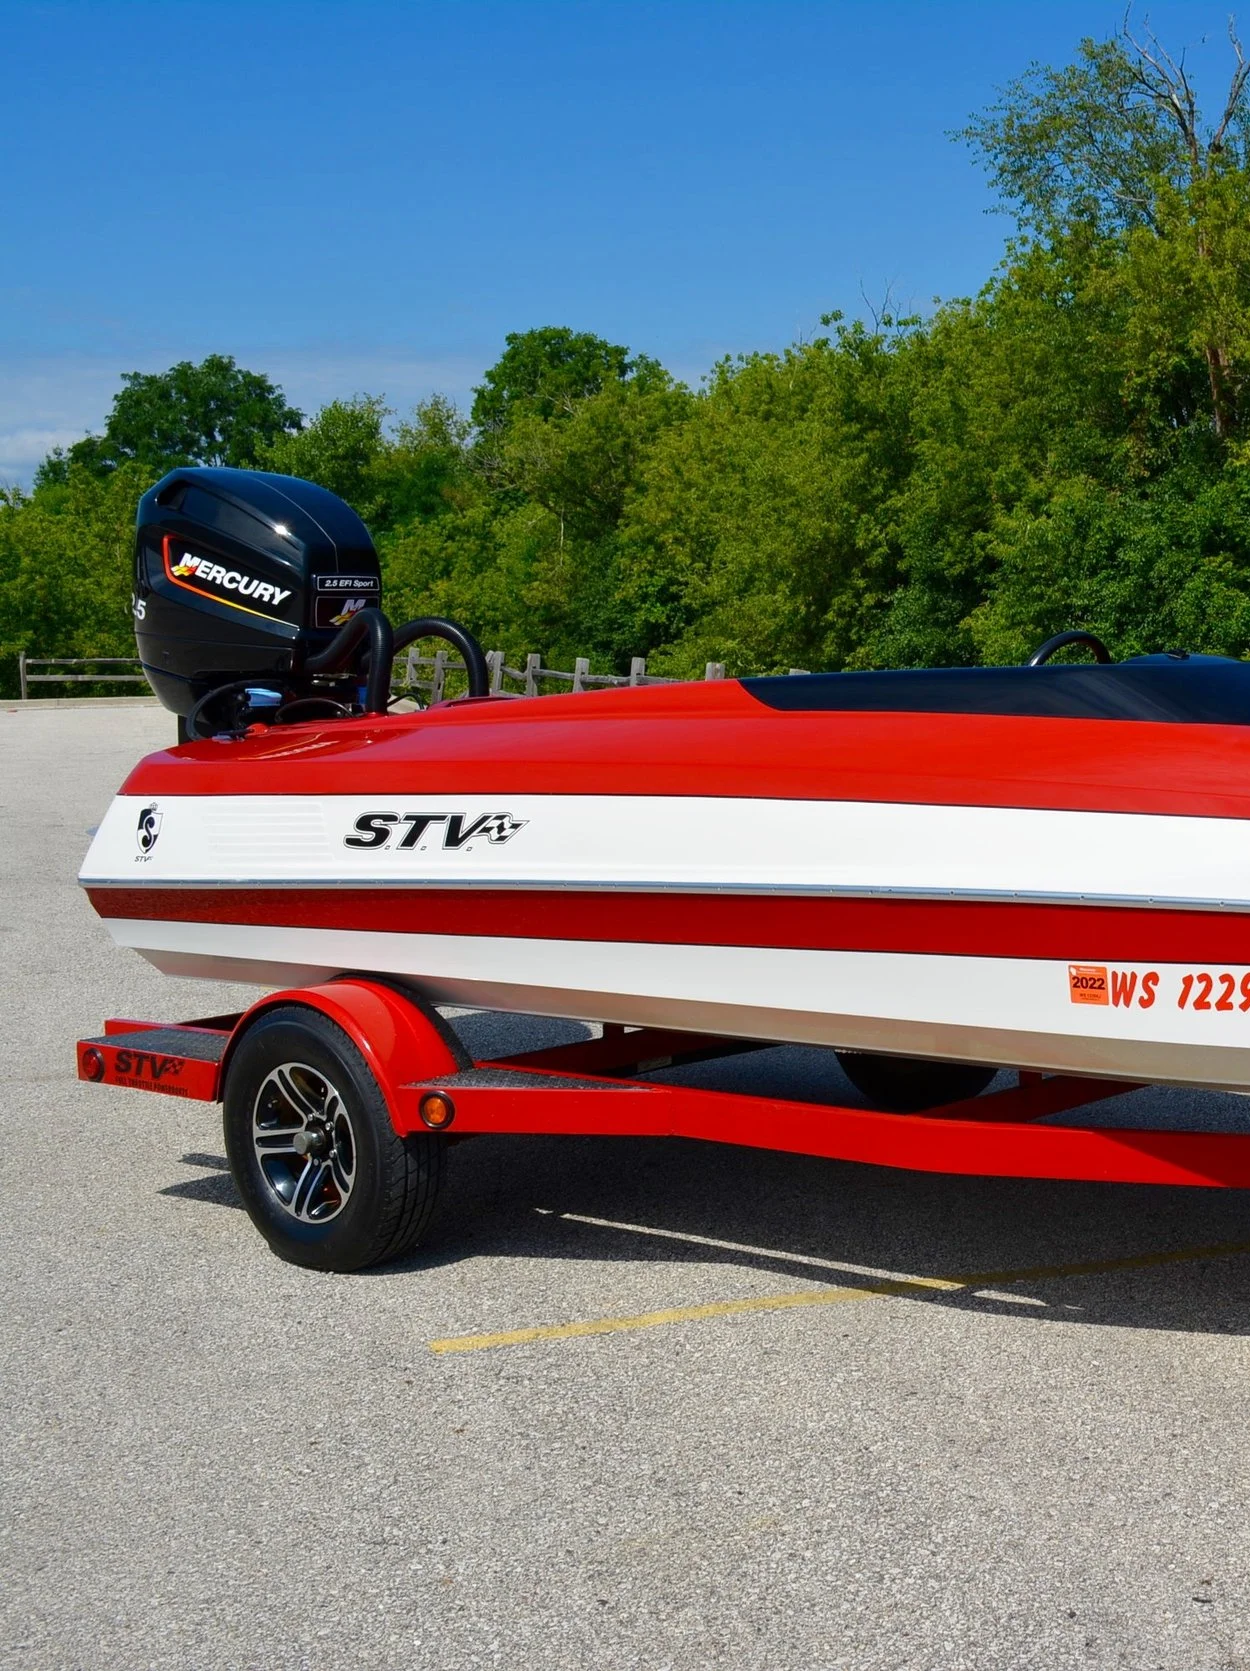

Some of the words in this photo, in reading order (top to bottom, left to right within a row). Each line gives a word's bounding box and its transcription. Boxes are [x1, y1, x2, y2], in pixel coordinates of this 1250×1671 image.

[171, 552, 292, 606] MERCURY
[324, 579, 338, 588] 2.5
[338, 579, 353, 588] EFI
[353, 579, 374, 589] Sport
[1071, 975, 1106, 990] 2022
[1111, 970, 1160, 1009] WS
[115, 1049, 170, 1079] STV
